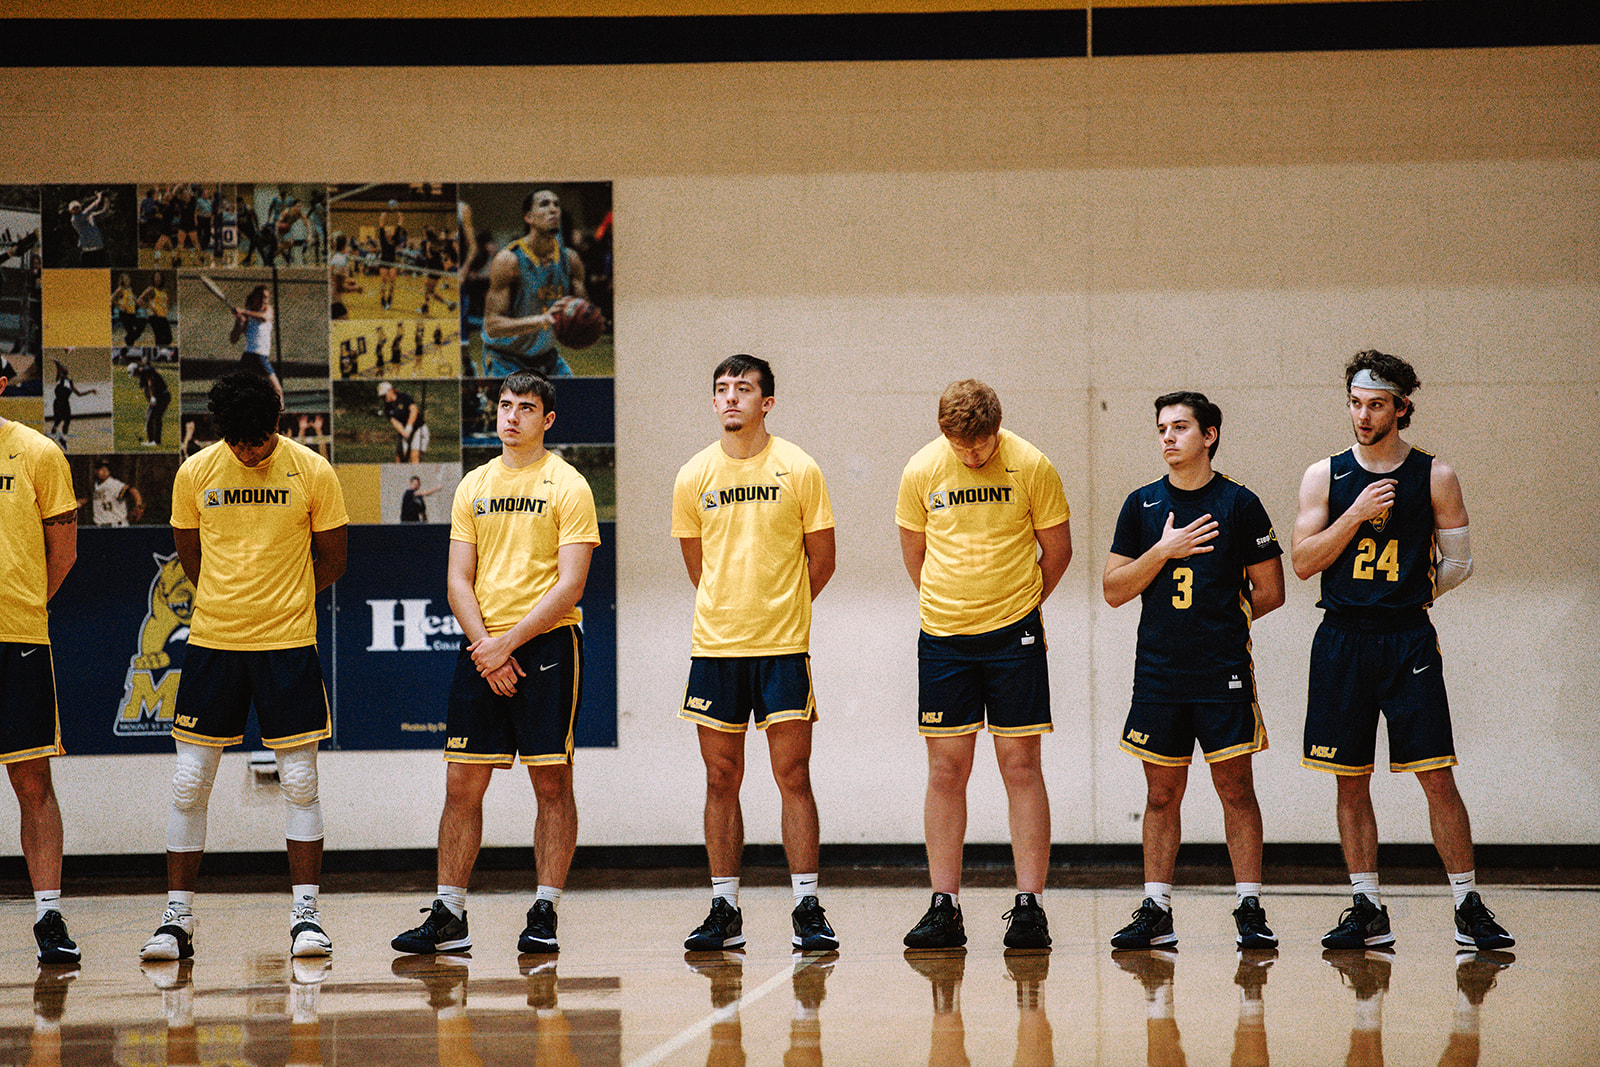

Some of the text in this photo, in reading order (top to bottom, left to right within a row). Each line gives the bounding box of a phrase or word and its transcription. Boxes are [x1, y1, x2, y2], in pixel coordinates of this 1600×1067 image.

[224, 489, 289, 504] MOUNT
[720, 486, 780, 505] MOUNT
[949, 487, 1012, 505] MOUNT
[490, 497, 547, 513] MOUNT
[1353, 537, 1399, 582] 24
[1172, 567, 1194, 609] 3
[365, 599, 465, 651] Hea
[120, 669, 182, 722] M
[687, 696, 712, 711] MSJ
[175, 713, 198, 728] MSJ
[922, 711, 943, 723] MSJ
[446, 736, 469, 749] MSJ
[1126, 728, 1150, 745] MSJ
[1310, 745, 1338, 759] MSJ
